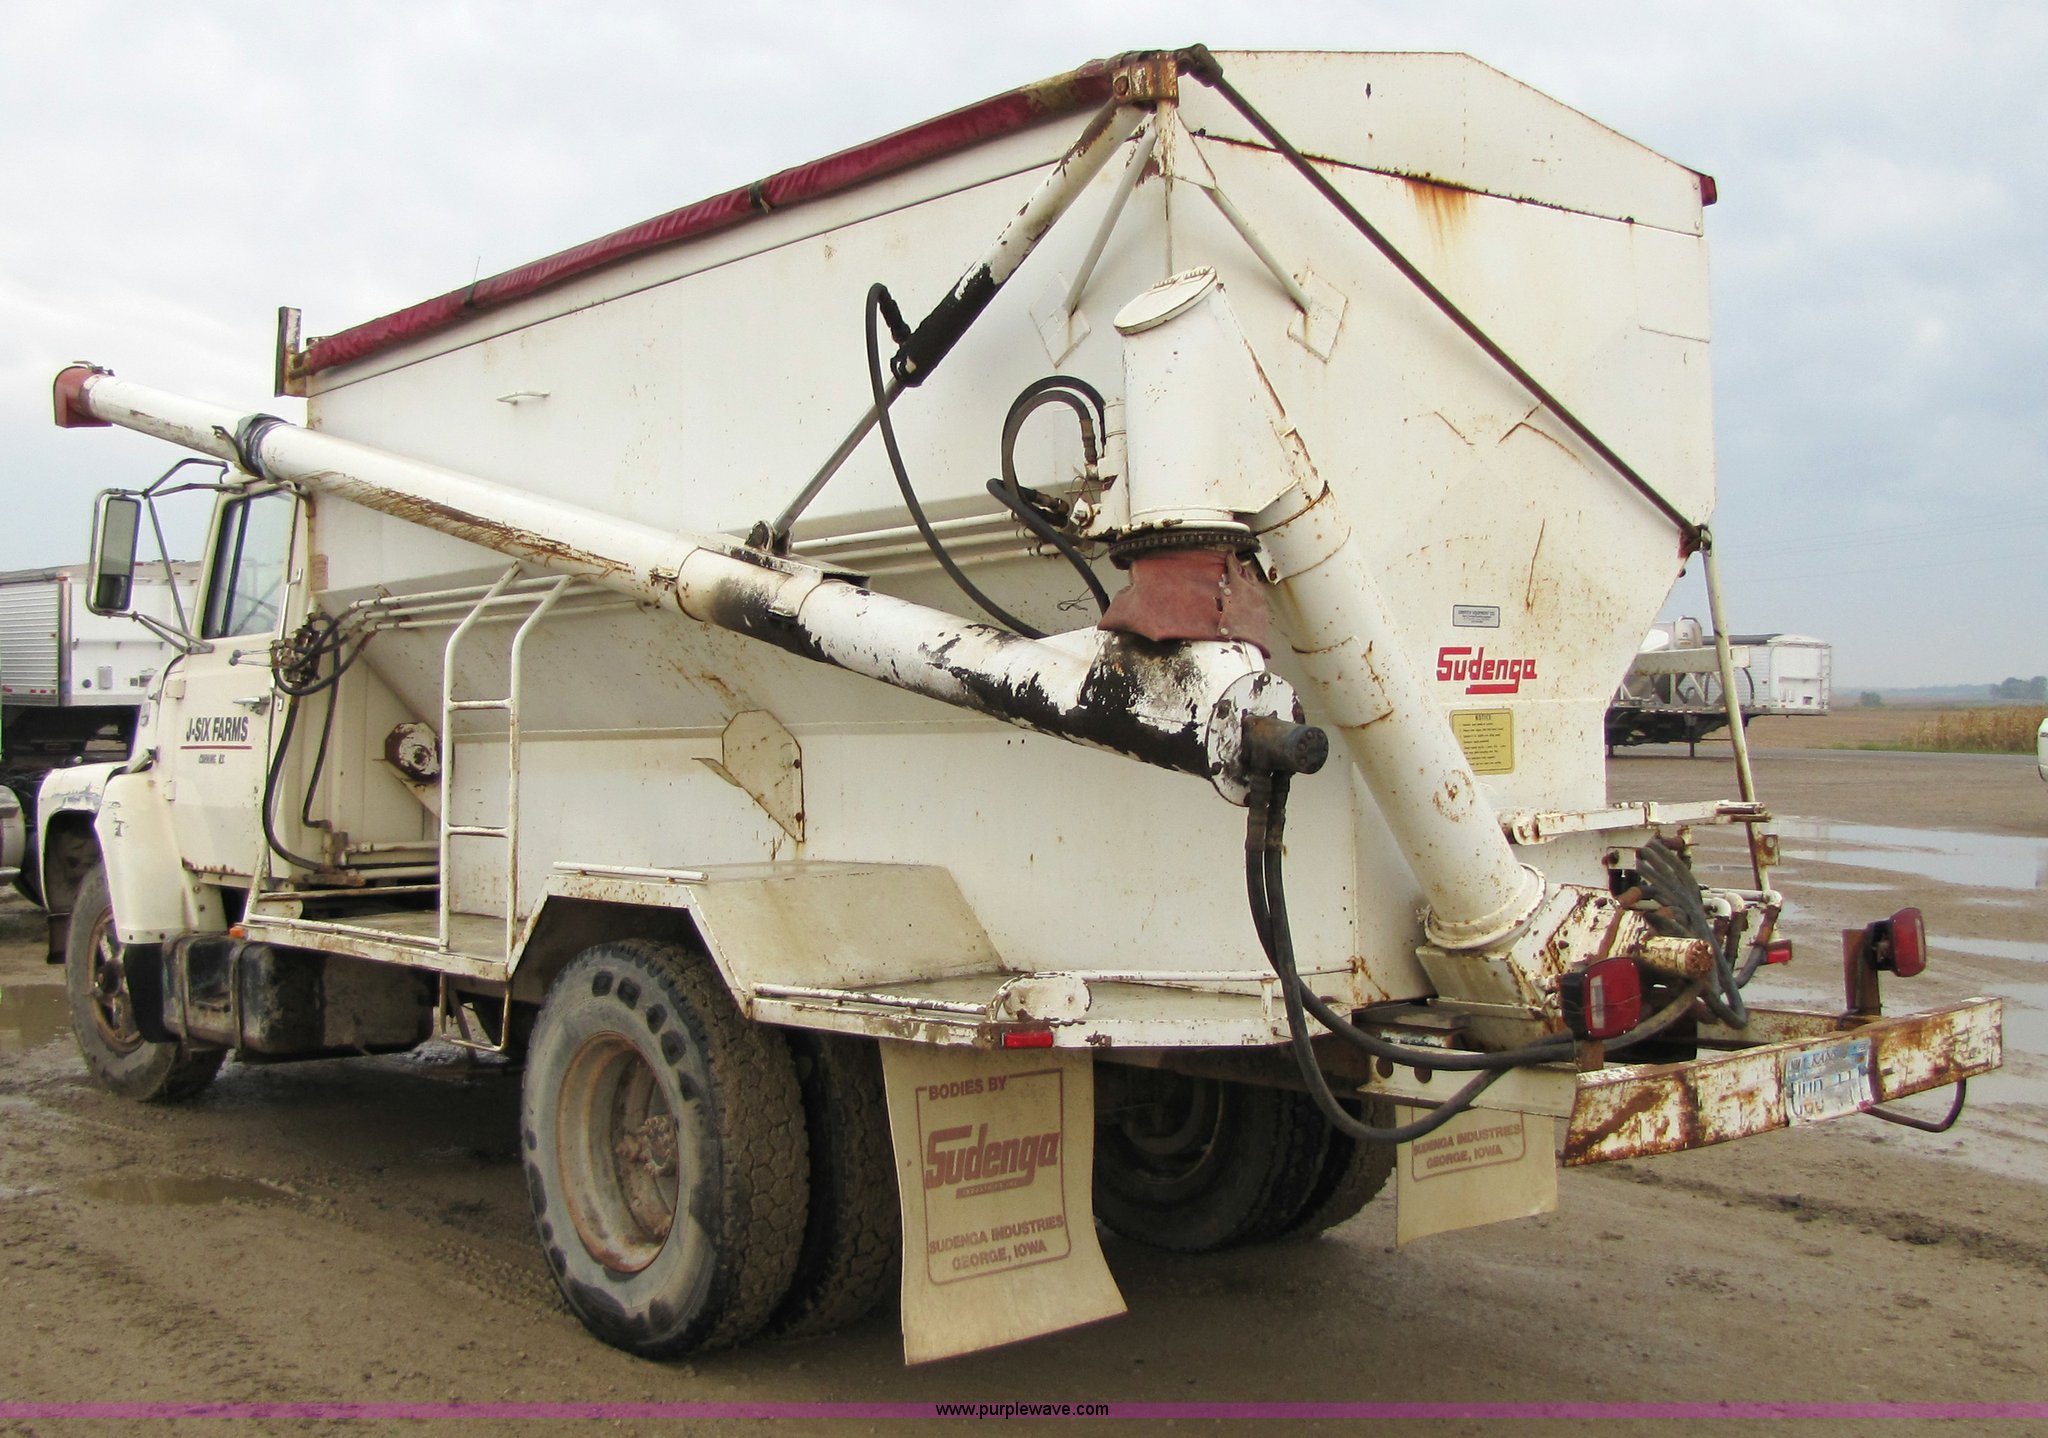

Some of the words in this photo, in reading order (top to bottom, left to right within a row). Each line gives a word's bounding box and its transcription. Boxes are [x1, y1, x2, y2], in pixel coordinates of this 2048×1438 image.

[1436, 647, 1538, 695] Sudenga
[186, 717, 212, 742] J-SIX
[212, 716, 249, 742] FARMS
[929, 1078, 984, 1101] BODIES
[988, 1075, 1008, 1093] BY
[1412, 1135, 1455, 1157] SUDENGA
[1456, 1123, 1522, 1145] INDUSTRIES
[1474, 1144, 1504, 1160] IOWA
[925, 1122, 1061, 1200] Sudenga
[928, 1230, 989, 1255] SUDENGA
[991, 1213, 1065, 1242] INDUSTRIES
[952, 1247, 1012, 1271] GEORGE,
[1014, 1238, 1048, 1259] IOWA
